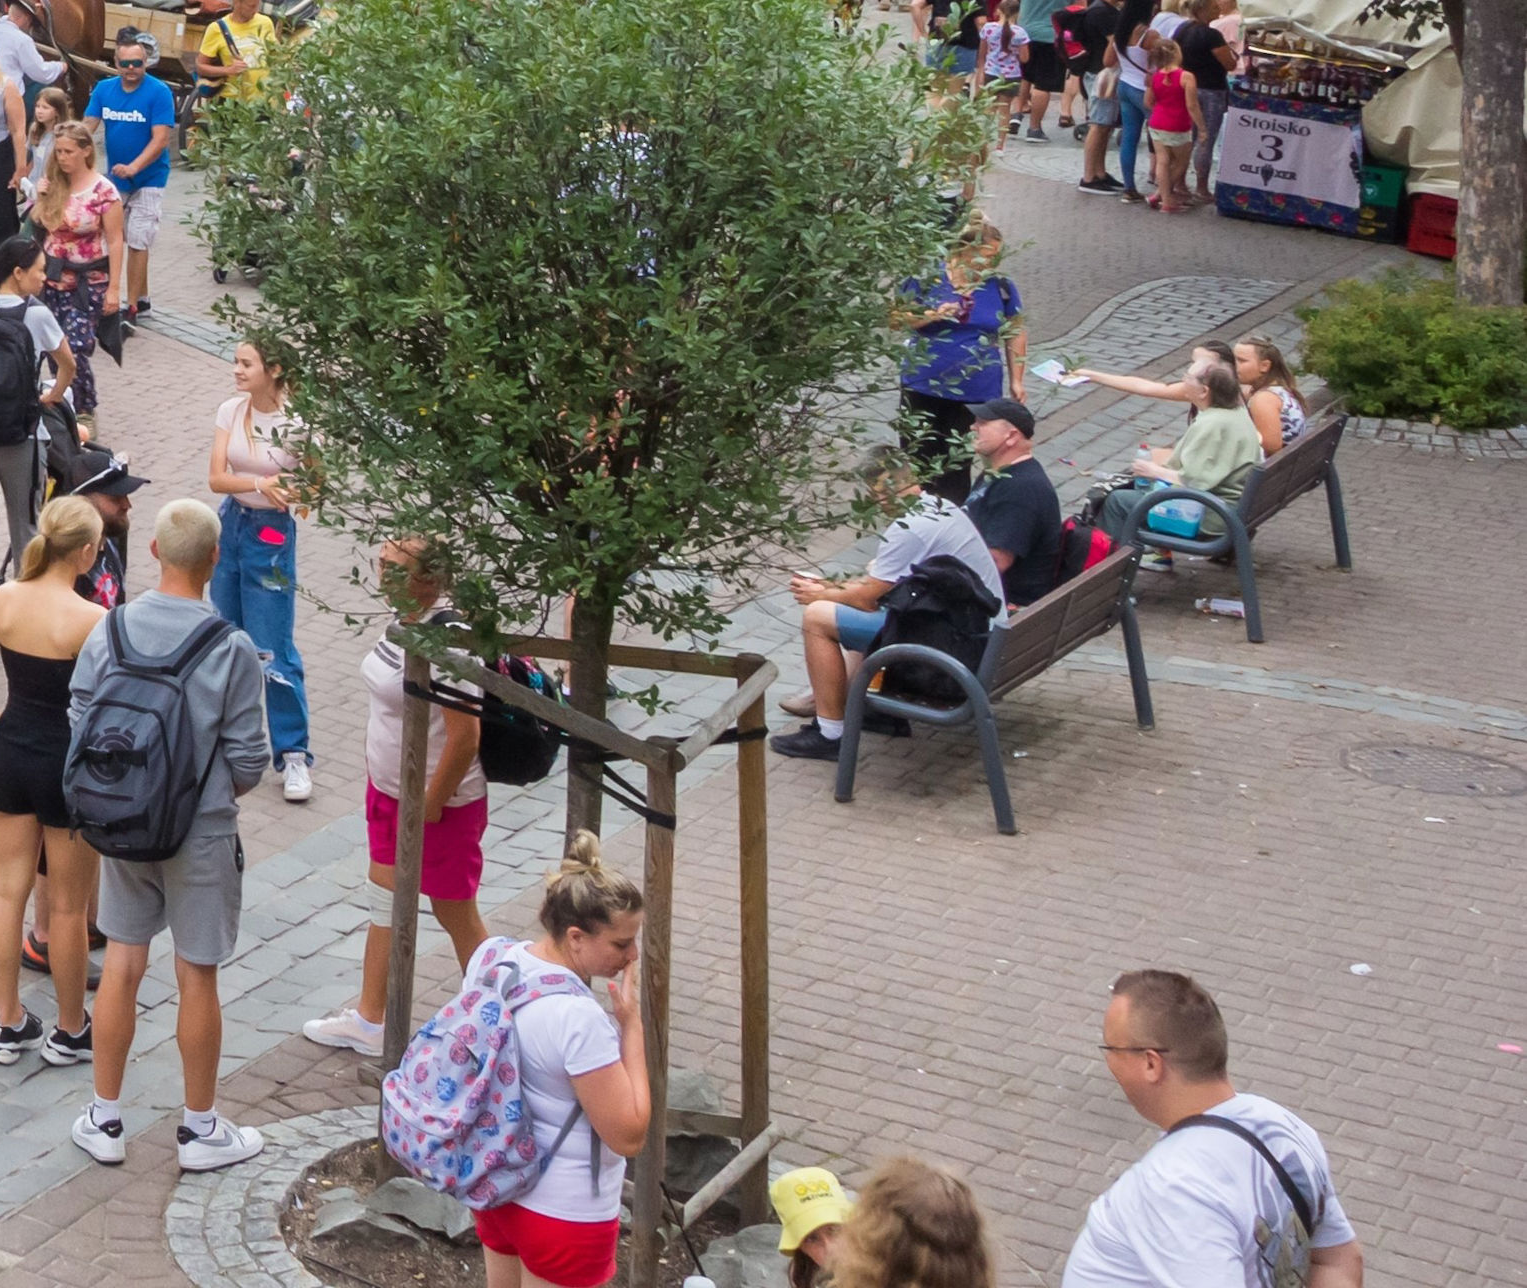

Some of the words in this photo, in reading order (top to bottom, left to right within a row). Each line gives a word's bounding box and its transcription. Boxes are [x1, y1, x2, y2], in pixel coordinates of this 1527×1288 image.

[102, 107, 146, 123] Bench.
[1238, 114, 1311, 137] Stoisko
[1256, 134, 1284, 162] 3
